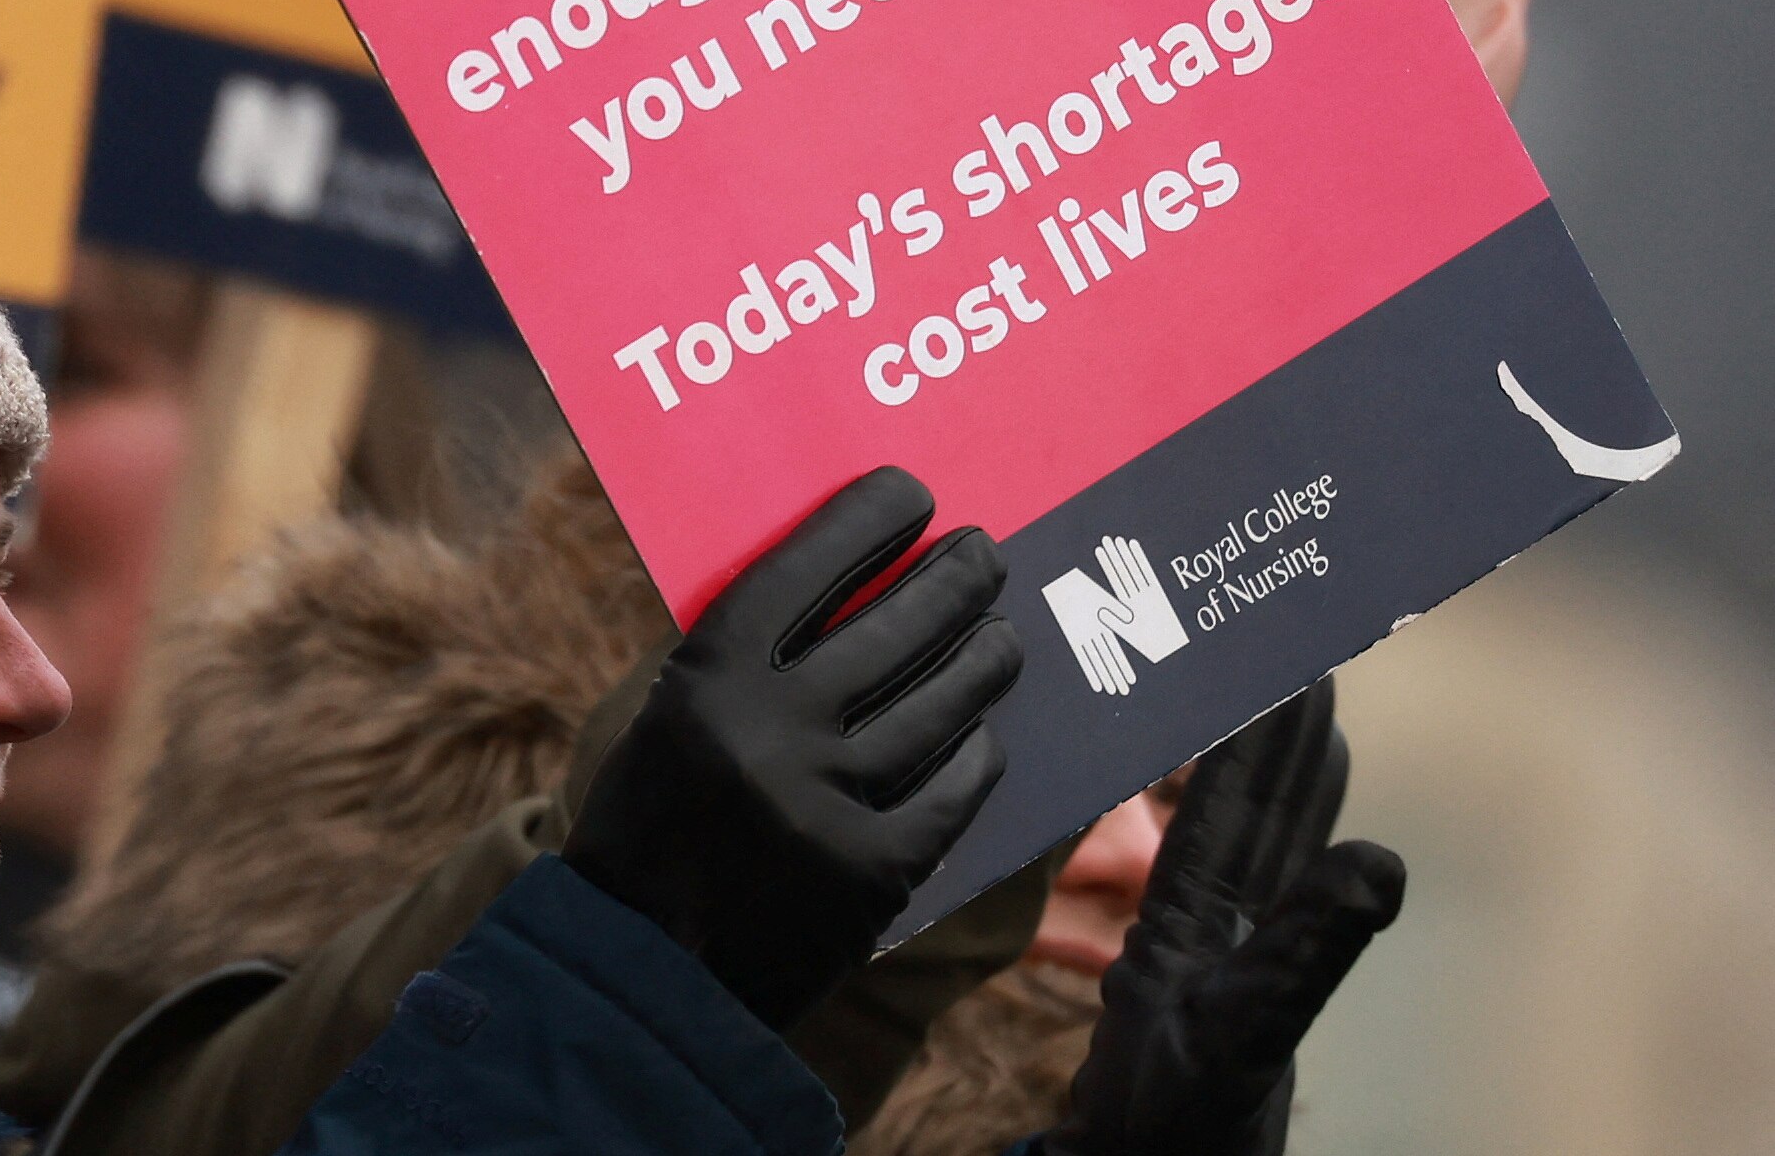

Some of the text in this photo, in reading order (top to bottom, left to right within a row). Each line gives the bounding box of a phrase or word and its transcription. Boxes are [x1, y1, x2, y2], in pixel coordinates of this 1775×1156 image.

[569, 39, 742, 194] you
[864, 140, 1240, 406] cost lives
[1170, 474, 1337, 590] Royal College
[1196, 538, 1329, 631] of Nursing
